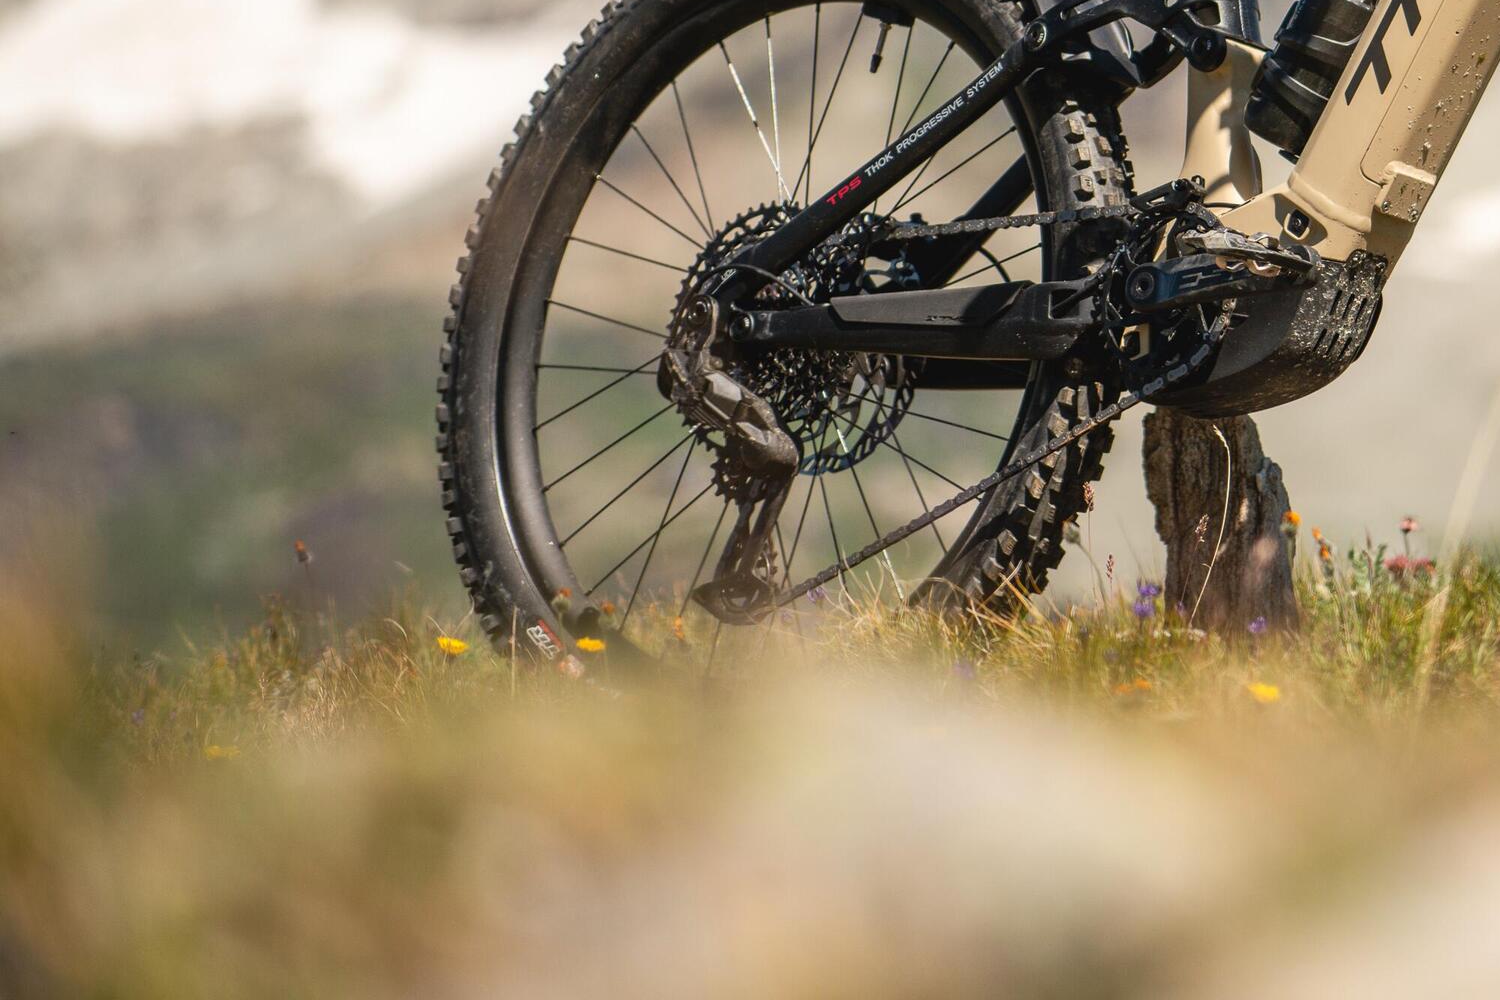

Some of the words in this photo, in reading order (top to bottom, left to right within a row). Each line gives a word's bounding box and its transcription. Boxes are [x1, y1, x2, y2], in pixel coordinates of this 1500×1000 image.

[827, 176, 863, 206] TPS
[864, 151, 894, 177] THOK
[896, 96, 964, 154] PROGRESSIVE
[966, 62, 1004, 98] SYSTEM
